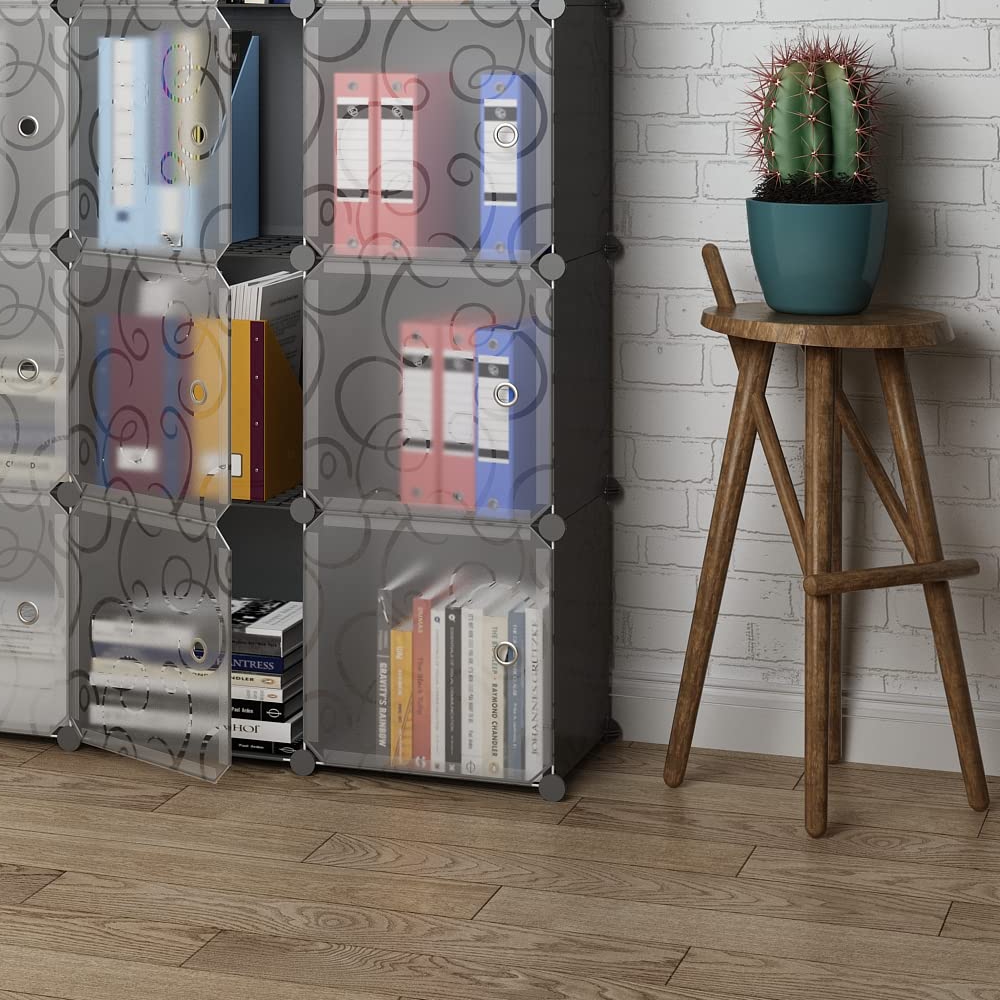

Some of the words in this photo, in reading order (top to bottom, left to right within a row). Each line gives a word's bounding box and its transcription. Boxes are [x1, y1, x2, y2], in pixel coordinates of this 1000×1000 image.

[378, 662, 388, 705] GRAVITY'S
[491, 683, 499, 719] RAYMOND
[378, 707, 387, 747] RAINBOW
[491, 720, 499, 757] CHANDLER
